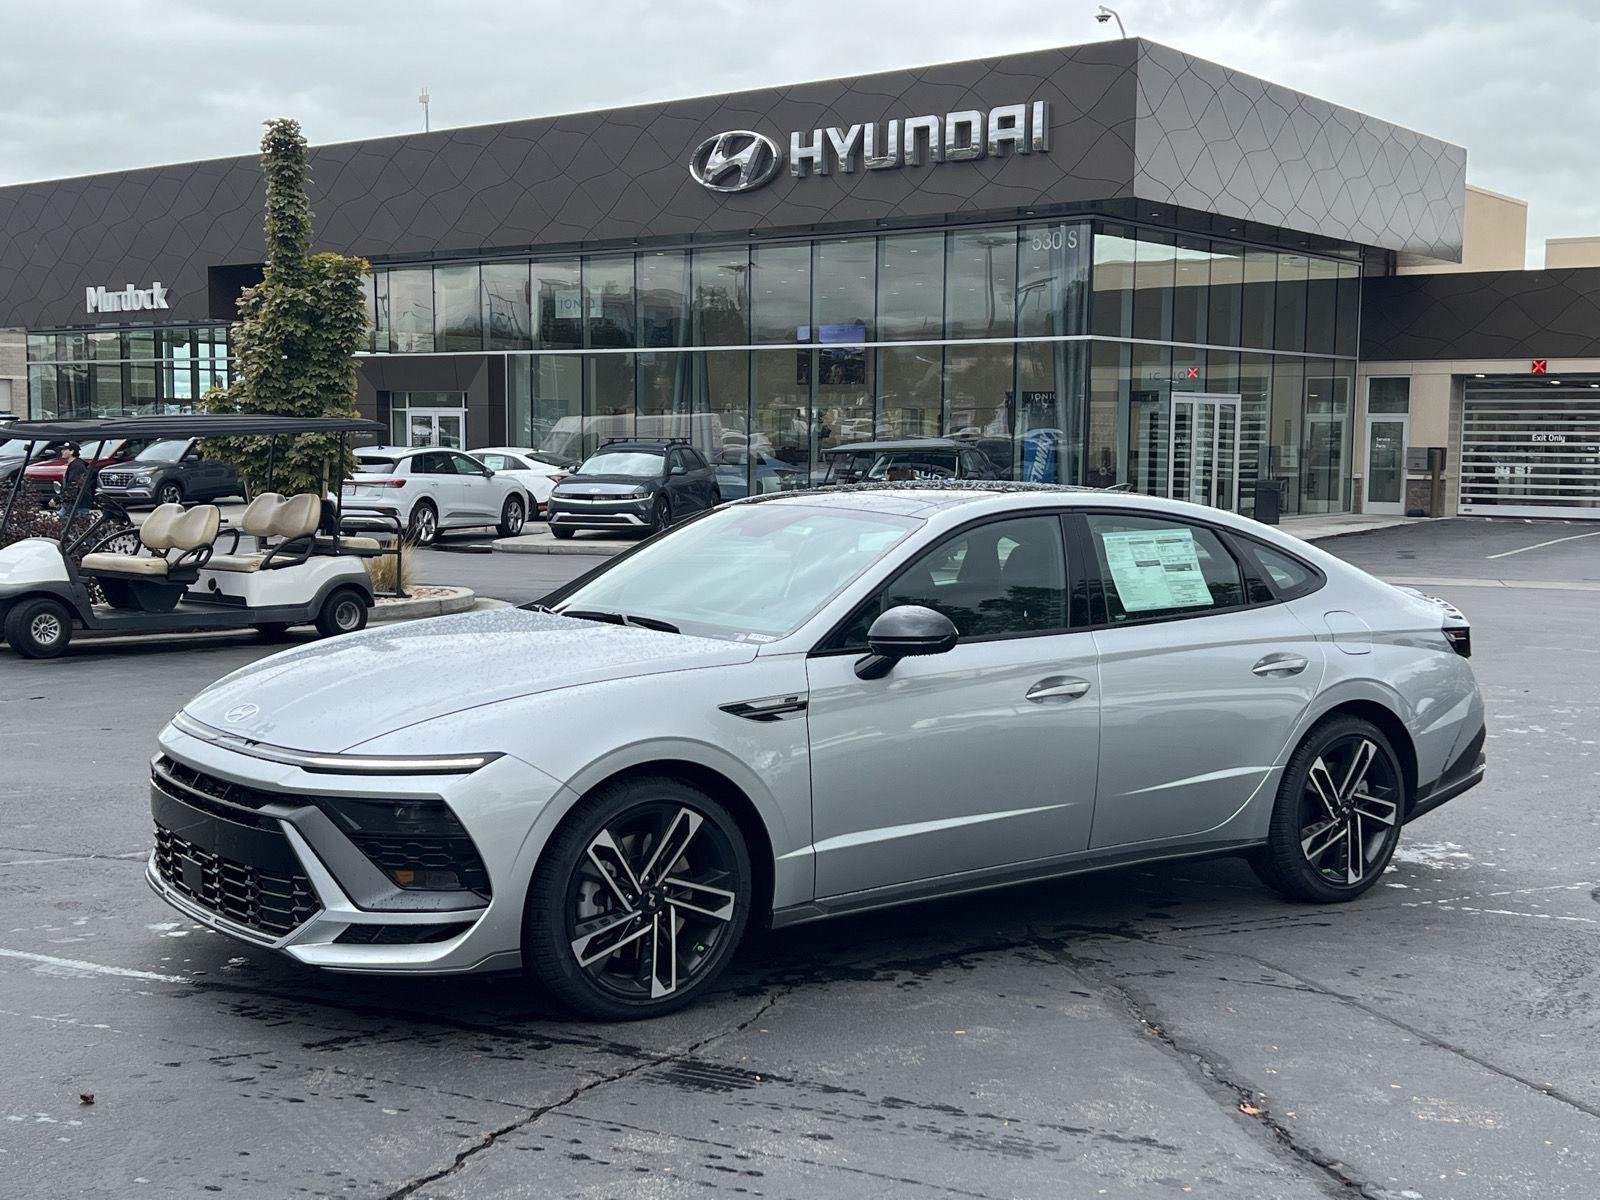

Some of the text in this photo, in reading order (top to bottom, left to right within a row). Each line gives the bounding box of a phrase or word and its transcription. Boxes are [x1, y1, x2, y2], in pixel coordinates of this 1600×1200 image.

[790, 101, 1049, 177] HYUNDAI
[86, 281, 169, 313] Murdock
[1532, 434, 1566, 445] Exit Only
